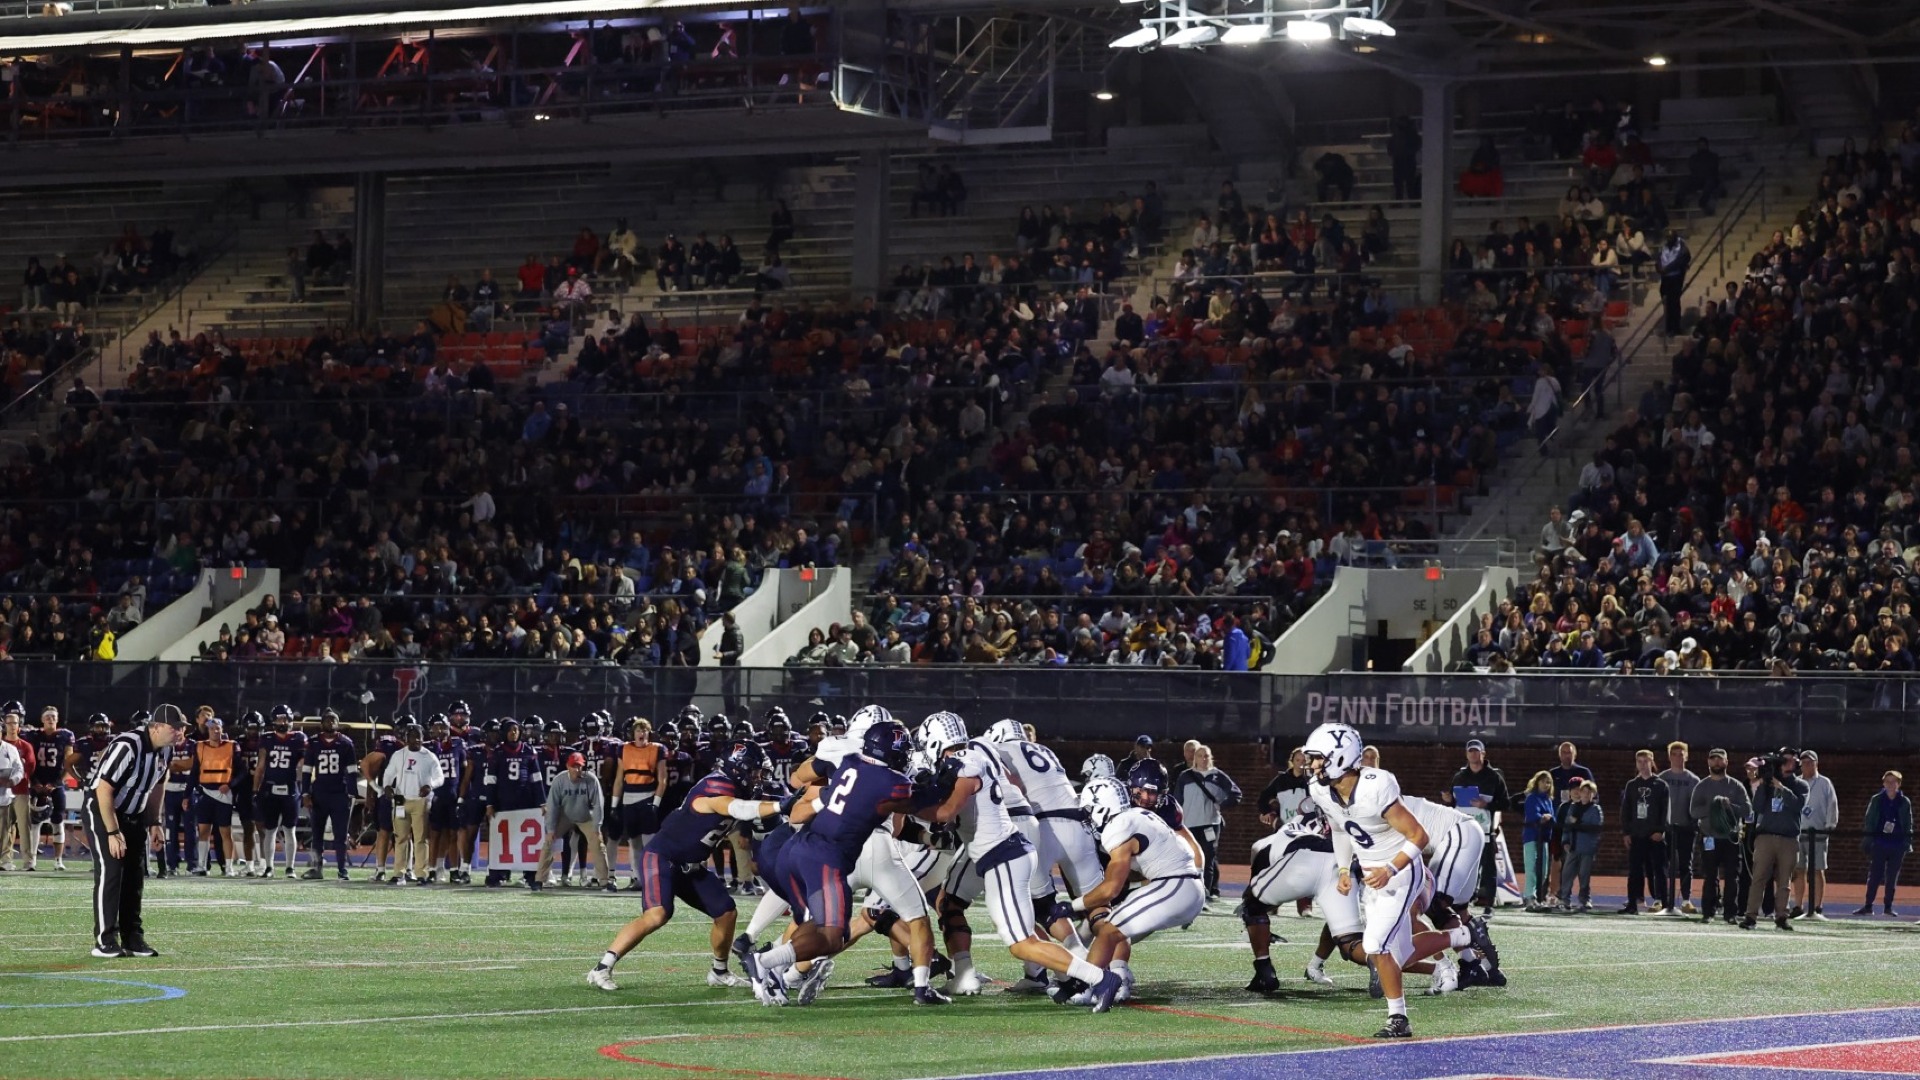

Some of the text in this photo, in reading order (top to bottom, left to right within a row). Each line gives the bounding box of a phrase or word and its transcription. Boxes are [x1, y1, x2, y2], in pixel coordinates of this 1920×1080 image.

[1413, 598, 1458, 610] SE SD
[1305, 691, 1517, 727] PENN FOOTBALL
[1327, 730, 1347, 749] Y
[37, 747, 58, 767] 43
[269, 750, 292, 768] 35
[318, 753, 340, 774] 28
[406, 758, 417, 770] P
[440, 758, 457, 778] 21
[508, 761, 520, 780] 9
[827, 767, 858, 815] 2
[1088, 784, 1101, 803] Y
[497, 818, 542, 864] 12
[1345, 820, 1374, 849] 9
